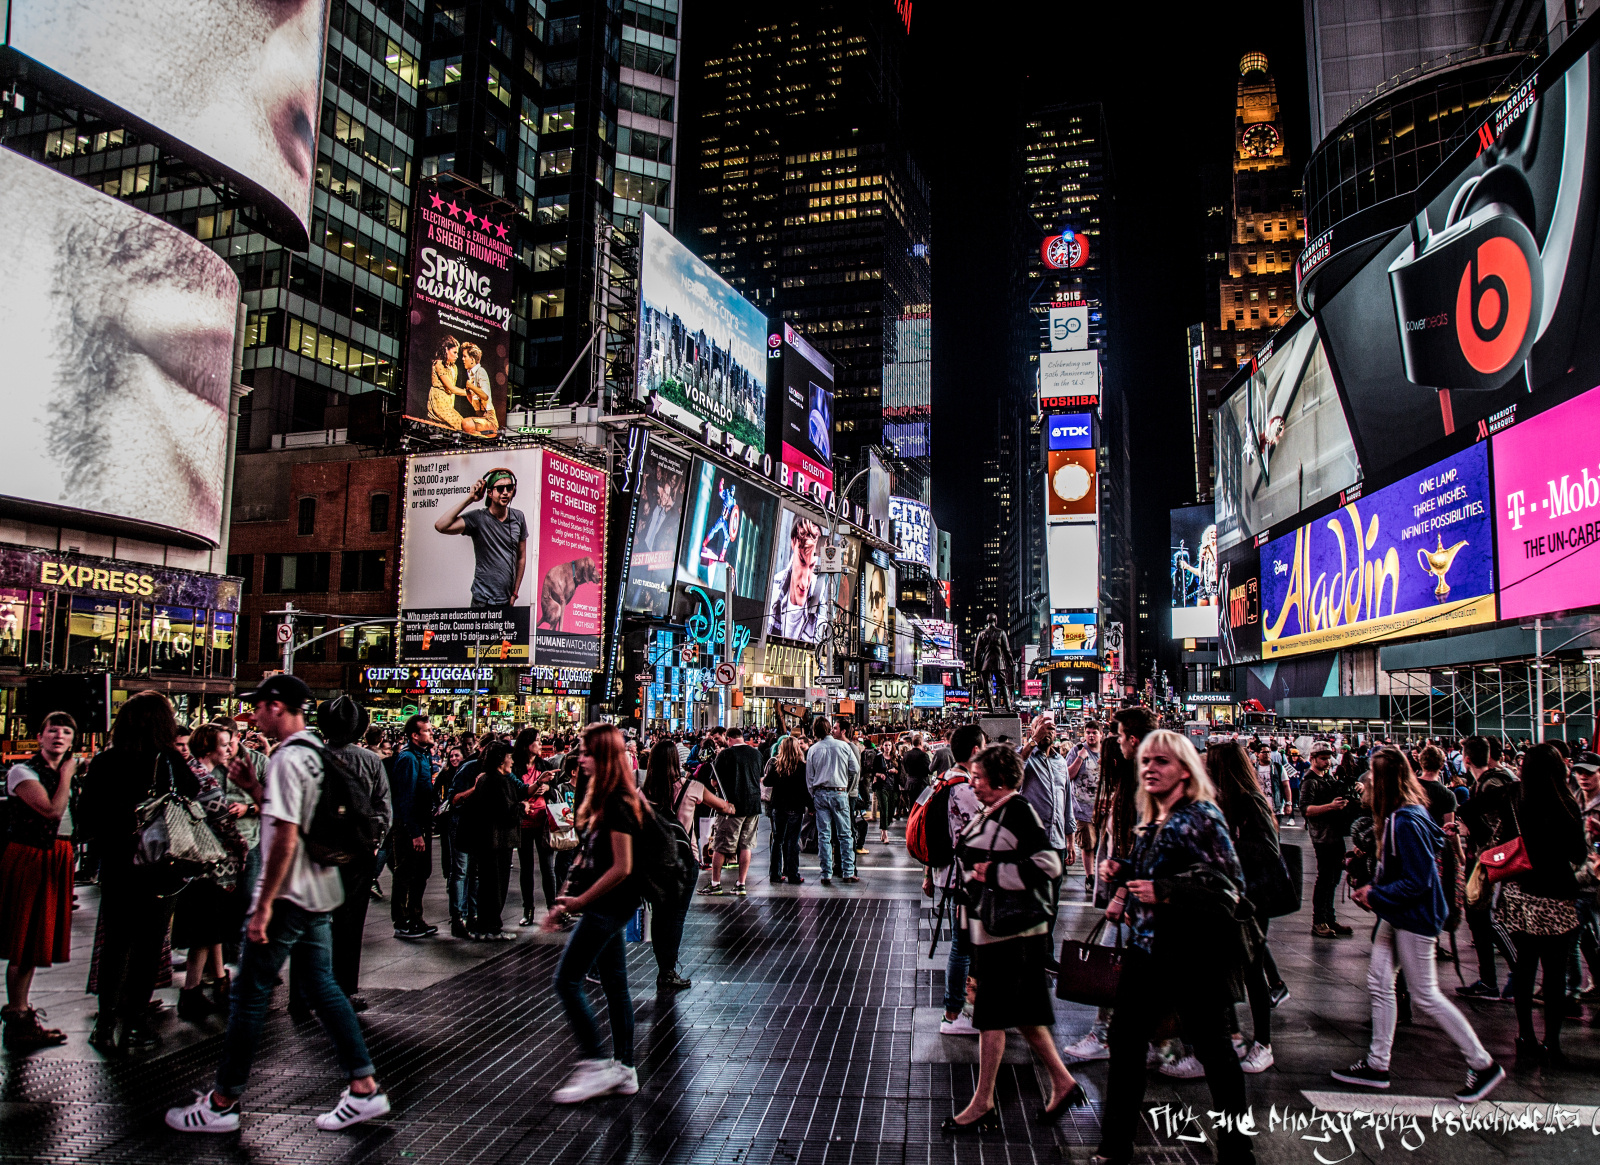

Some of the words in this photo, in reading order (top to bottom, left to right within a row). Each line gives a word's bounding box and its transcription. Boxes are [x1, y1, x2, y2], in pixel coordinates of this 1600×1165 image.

[1495, 73, 1539, 123] MARRIOTT
[1496, 91, 1535, 137] MARQUIS
[428, 224, 434, 240] A
[436, 227, 463, 252] SHEER
[467, 230, 472, 239] &
[1301, 230, 1334, 263] MARRIOTT
[1302, 245, 1330, 275] MARQUIS
[421, 247, 491, 297] SPRING
[417, 276, 512, 331] awakening
[1050, 300, 1086, 308] TOSHIBA
[1056, 291, 1080, 301] 2015
[1054, 317, 1081, 340] 50
[1405, 311, 1449, 333] powerbeats
[768, 350, 781, 359] LG
[1060, 370, 1095, 379] Anniversary
[684, 382, 733, 423] VORNADO
[1041, 395, 1098, 407] TOSHIBA
[692, 404, 710, 419] REALTY
[711, 413, 726, 427] TRUST
[1489, 404, 1517, 423] MARRIOTT
[519, 427, 550, 435] LAMAR
[1060, 426, 1089, 437] TDK
[1489, 414, 1515, 433] MARQUIS
[414, 463, 434, 473] What?
[438, 463, 449, 473] get
[550, 458, 568, 474] HSUS
[570, 465, 599, 486] DOESN'T
[413, 475, 439, 485] $30,000
[444, 474, 459, 485] year
[548, 474, 564, 489] GIVE
[566, 480, 589, 497] SQUAT
[590, 489, 600, 500] TO
[1419, 480, 1435, 495] ONE
[1436, 468, 1459, 490] LAMP.
[412, 487, 426, 497] with
[427, 488, 435, 496] no
[436, 486, 471, 496] experience
[780, 461, 886, 538] BROADWAY
[1413, 500, 1436, 517] THREE
[1436, 485, 1468, 506] WISHES.
[419, 499, 439, 508] skills?
[550, 490, 563, 503] PET
[564, 495, 597, 515] SHELTERS
[576, 515, 589, 526] Society
[1401, 520, 1429, 540] INFINITE
[1430, 501, 1485, 529] POSSIBILITIES.
[1523, 536, 1546, 559] THE
[631, 554, 645, 565] BEST
[40, 561, 154, 596] EXPRESS
[1262, 502, 1400, 641] Aladdin
[407, 612, 420, 620] Who
[421, 612, 439, 620] needs
[440, 612, 448, 620] an
[448, 611, 479, 620] education
[487, 610, 502, 619] hard
[1053, 615, 1070, 623] FOX
[406, 623, 421, 631] work
[439, 622, 452, 630] Gov.
[453, 621, 474, 630] Cuomo
[481, 621, 503, 631] raising
[504, 621, 515, 629] the
[434, 632, 450, 642] wage
[451, 632, 458, 640] to
[460, 632, 467, 640] 15
[536, 635, 600, 652] HUMANEWATCH.ORG
[762, 643, 807, 677] FOREVER
[367, 668, 409, 681] GIFTS
[420, 668, 493, 681] LUGGAGE
[531, 667, 553, 680] GIFTS
[559, 669, 593, 682] LUGGAGE
